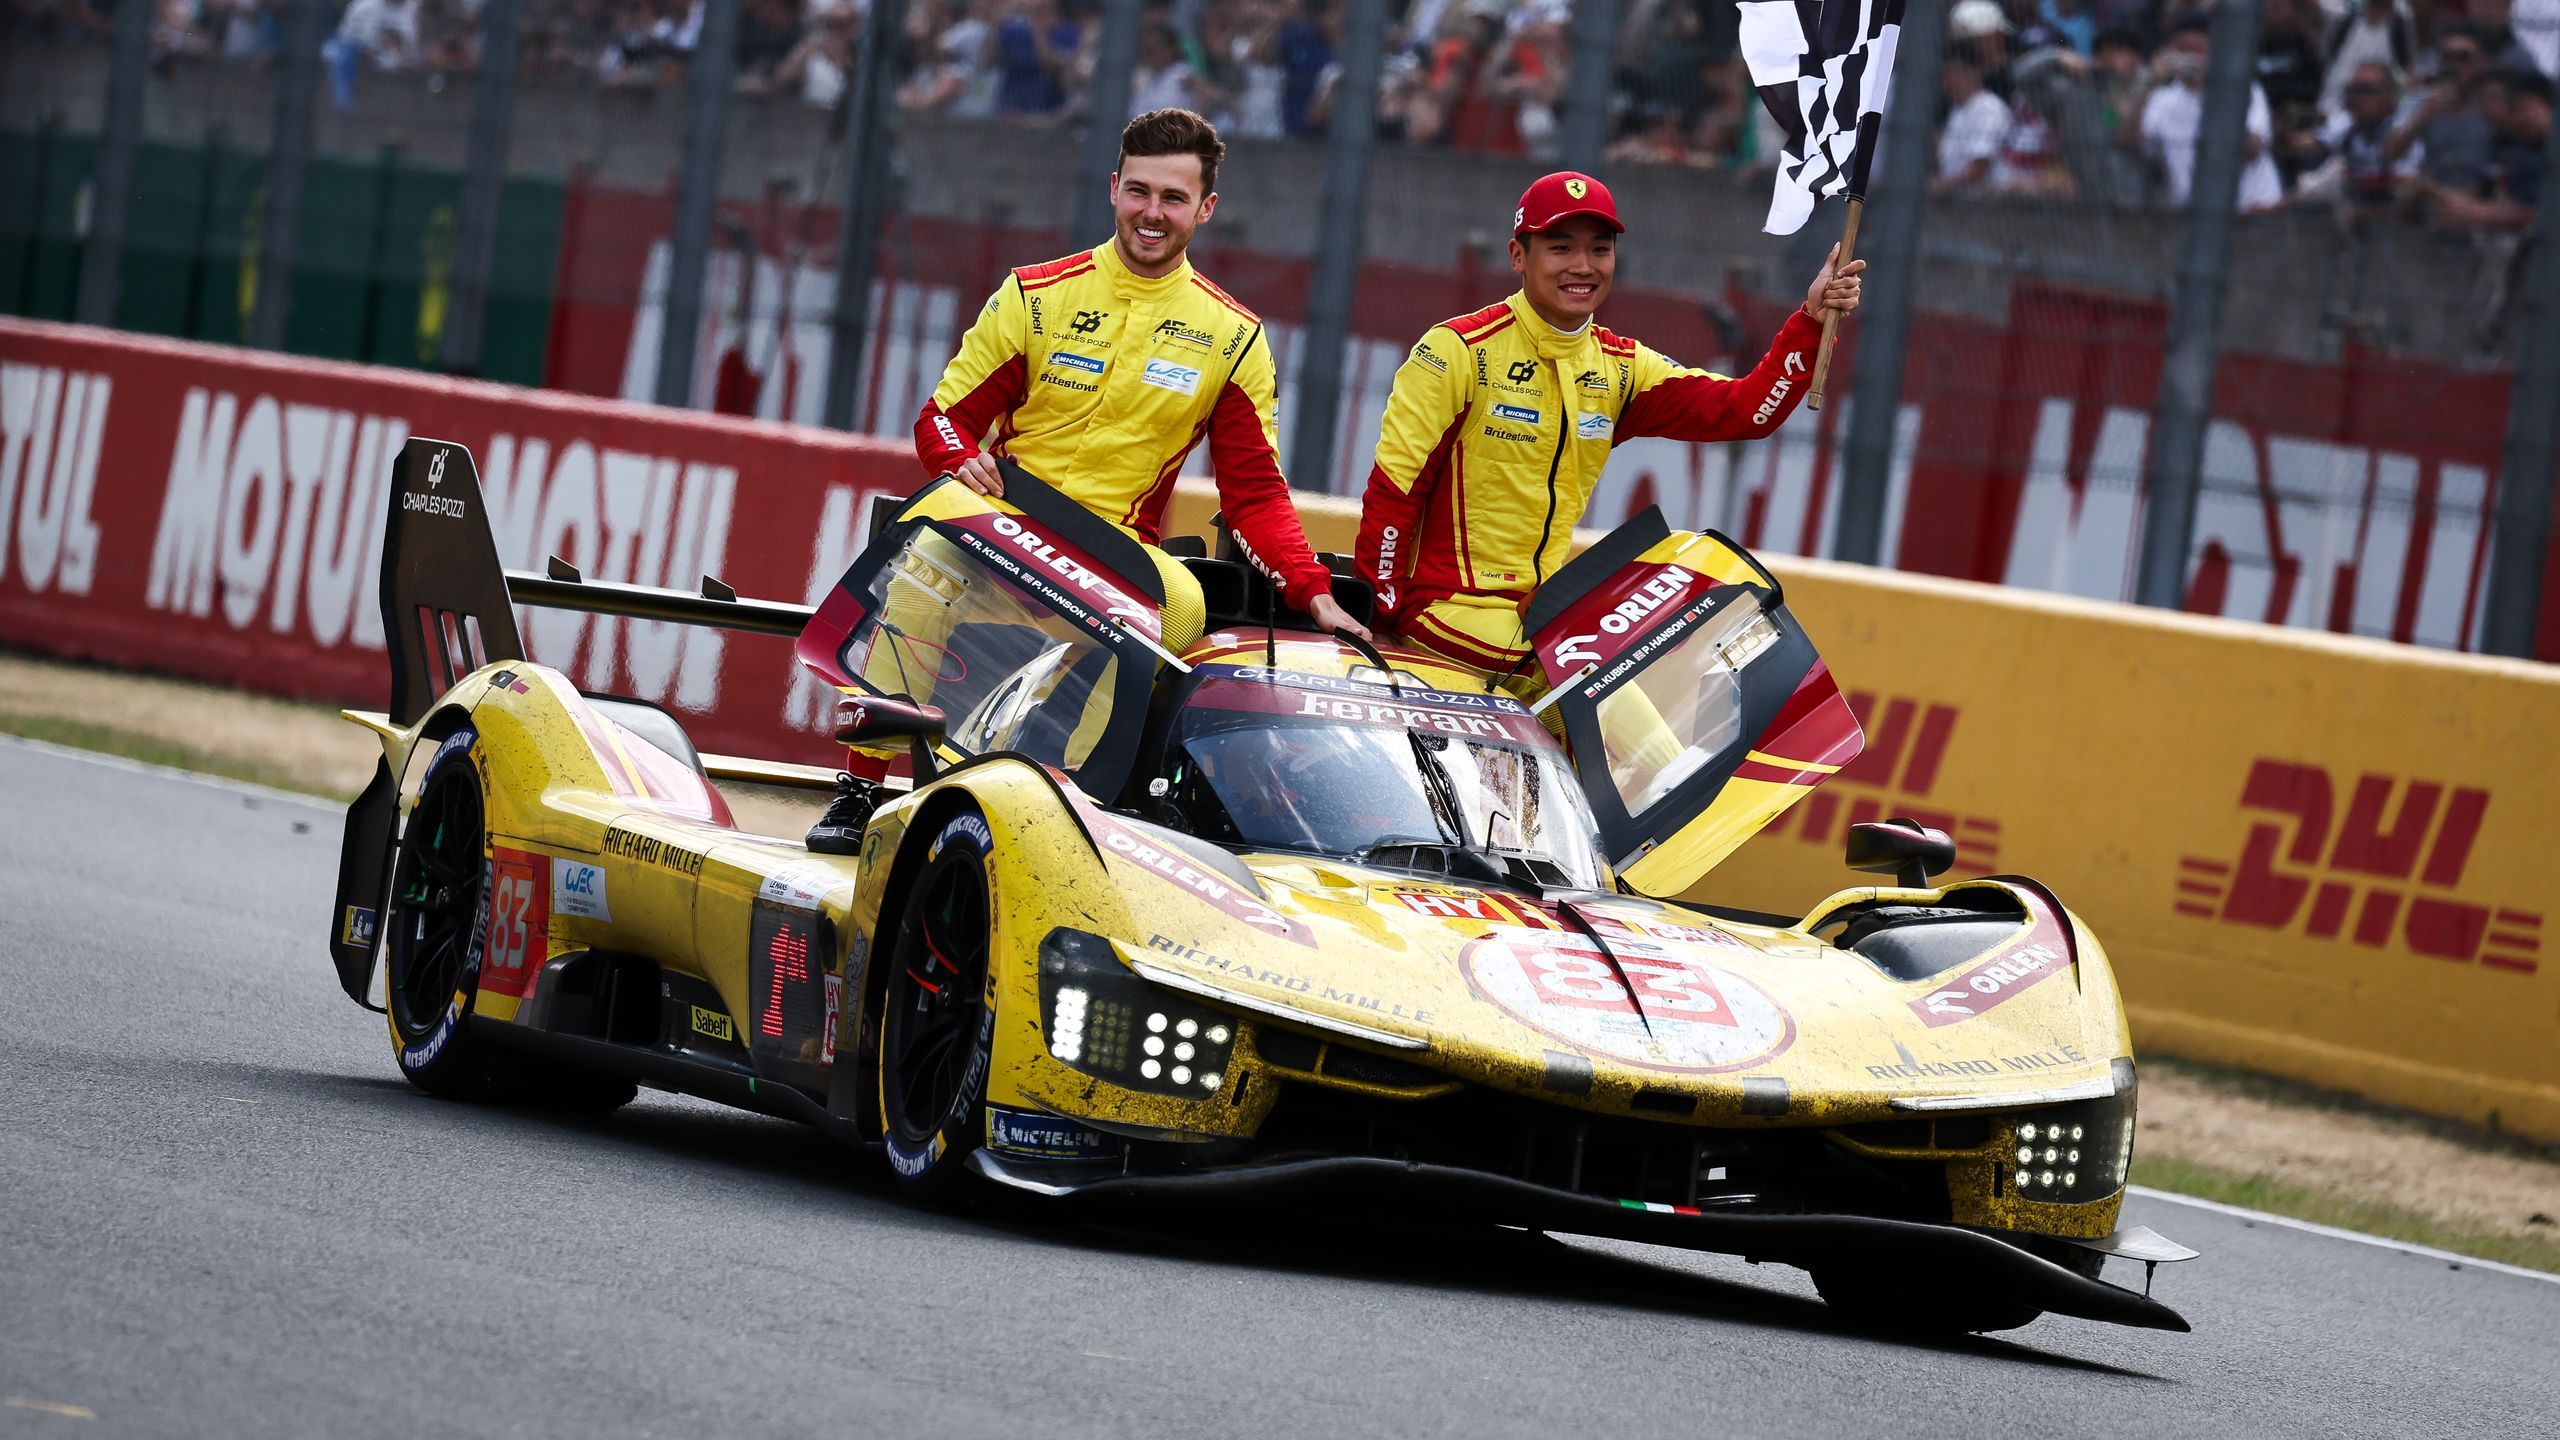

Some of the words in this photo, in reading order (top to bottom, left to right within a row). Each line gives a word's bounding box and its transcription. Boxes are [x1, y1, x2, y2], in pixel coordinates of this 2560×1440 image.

[1030, 296, 1044, 336] Sabelt
[1178, 327, 1215, 341] corse
[1087, 338, 1112, 349] POZZI
[1222, 324, 1248, 359] Sabelt
[1059, 354, 1101, 371] MICHELIN
[1146, 361, 1199, 383] WEC
[1476, 347, 1488, 388] Sabelt
[1491, 382, 1525, 395] CHARLES
[1752, 376, 1793, 425] ORLEN
[1484, 425, 1538, 443] Britestone
[1505, 409, 1536, 420] MICHELIN
[145, 387, 412, 652] MOTUL
[402, 491, 441, 515] CHARLES
[440, 497, 465, 519] POZZI
[992, 517, 1103, 590] ORLEN
[1232, 528, 1270, 578] ORLEN
[1377, 525, 1399, 581] ORLEN
[982, 546, 1020, 576] KUBICA
[1041, 586, 1088, 619] HANSON
[1599, 564, 1695, 635] ORLEN
[1232, 667, 1395, 697] CHARLES
[1399, 689, 1489, 708] POZZI
[1296, 691, 1518, 742] Ferrari
[604, 826, 662, 865] RICHARD
[660, 844, 702, 877] MILLE
[944, 814, 991, 848] MICHELIN
[1106, 831, 1230, 901] ORLEN
[2220, 757, 2492, 963] DHL
[565, 867, 595, 896] WEC
[490, 875, 533, 969] 83
[1398, 894, 1488, 919] HY
[1146, 933, 1313, 994] RICHARD
[1319, 984, 1437, 1026] MILLE
[1530, 952, 1718, 1013] 83
[1968, 942, 2060, 995] ORLEN
[695, 1008, 728, 1038] Sabelt
[404, 1022, 447, 1069] MICHELIN
[1865, 1057, 1999, 1080] RICHARD
[1999, 1045, 2088, 1073] MILLE
[1010, 1126, 1100, 1147] MICHELIN
[886, 1139, 926, 1177] MICHELIN
